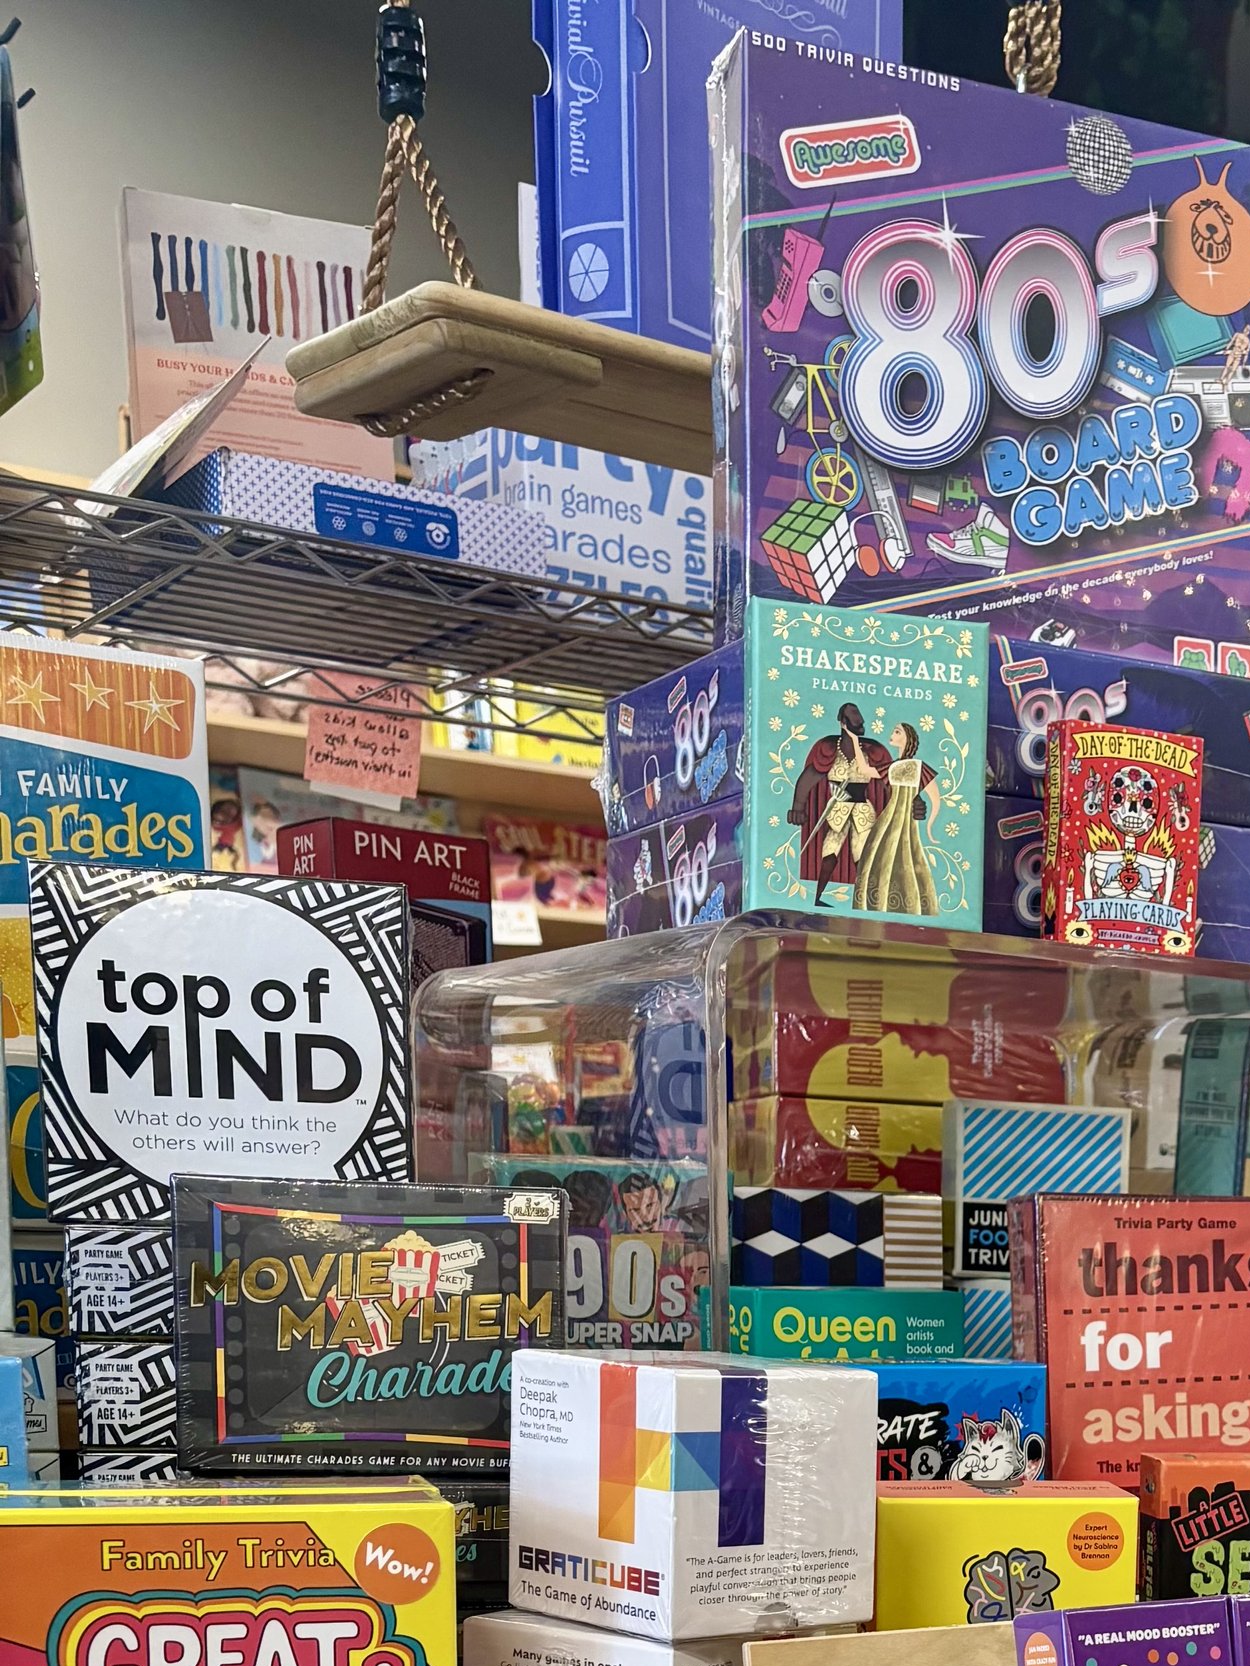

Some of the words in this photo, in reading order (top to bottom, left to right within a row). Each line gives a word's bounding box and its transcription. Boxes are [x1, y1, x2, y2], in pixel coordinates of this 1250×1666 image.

[751, 31, 786, 51] 500
[795, 41, 854, 67] TRIVIA
[862, 56, 961, 92] QUESTIONS
[566, 52, 602, 177] Pursuit
[792, 134, 907, 175] Awesome
[840, 210, 1160, 470] 80s
[156, 358, 188, 371] BUSY
[189, 362, 222, 376] YOUR
[982, 393, 1202, 498] BOARD
[503, 474, 551, 507] brain
[561, 484, 643, 526] games
[1011, 452, 1200, 547] GAME
[982, 592, 1044, 613] knowledge
[1081, 571, 1124, 589] decade
[1124, 558, 1180, 581] everybody
[1181, 550, 1214, 567] loves!
[779, 645, 964, 685] SHAKESPEARE
[811, 677, 879, 700] PLAYING
[881, 683, 934, 702] CARDS
[17, 768, 128, 803] FAMILY
[292, 833, 315, 854] PIN
[354, 830, 401, 861] PIN
[413, 838, 467, 870] ART
[292, 854, 316, 875] ART
[250, 967, 330, 1025] of
[86, 1021, 363, 1104] MIND
[114, 1108, 170, 1129] What
[175, 1110, 202, 1129] do
[207, 1114, 246, 1135] you
[250, 1113, 301, 1133] think
[305, 1115, 338, 1135] the
[131, 1133, 198, 1153] others
[202, 1134, 235, 1153] will
[239, 1137, 321, 1157] answer?
[1114, 1215, 1156, 1230] Trivia
[1159, 1215, 1194, 1232] Party
[1197, 1216, 1237, 1231] Game
[441, 1248, 476, 1263] TICKET
[85, 1272, 114, 1281] PLAYERS
[190, 1250, 397, 1308] MOVIE
[86, 1294, 105, 1307] AGE
[277, 1290, 553, 1351] MAYHEM
[630, 1322, 695, 1346] SNAP
[772, 1305, 897, 1344] Queen
[906, 1315, 945, 1329] Women
[906, 1330, 935, 1343] artists
[906, 1342, 933, 1355] book
[1079, 1319, 1174, 1372] for
[519, 1386, 558, 1404] Deepak
[519, 1402, 558, 1421] Chopra,
[231, 1453, 253, 1465] THE
[255, 1453, 303, 1465] ULTIMATE
[306, 1454, 364, 1466] CHARADES
[368, 1455, 396, 1466] GAME
[400, 1455, 422, 1467] FOR
[426, 1456, 448, 1467] ANY
[451, 1457, 486, 1468] MOVIE
[1072, 1533, 1119, 1541] Neuroscience
[1085, 1524, 1108, 1532] Expert
[1176, 1501, 1246, 1543] LITTLE
[101, 1540, 229, 1581] Family
[238, 1538, 336, 1569] Trivia
[364, 1541, 435, 1585] Wow!
[801, 1550, 828, 1561] lovers,
[828, 1547, 859, 1560] friends,
[1081, 1552, 1110, 1560] Brennan
[518, 1544, 661, 1597] GRATICUBE
[521, 1580, 541, 1596] The
[544, 1586, 577, 1605] Game
[595, 1597, 657, 1621] Abundance
[1094, 1631, 1126, 1645] REAL
[1126, 1628, 1160, 1642] MOOD
